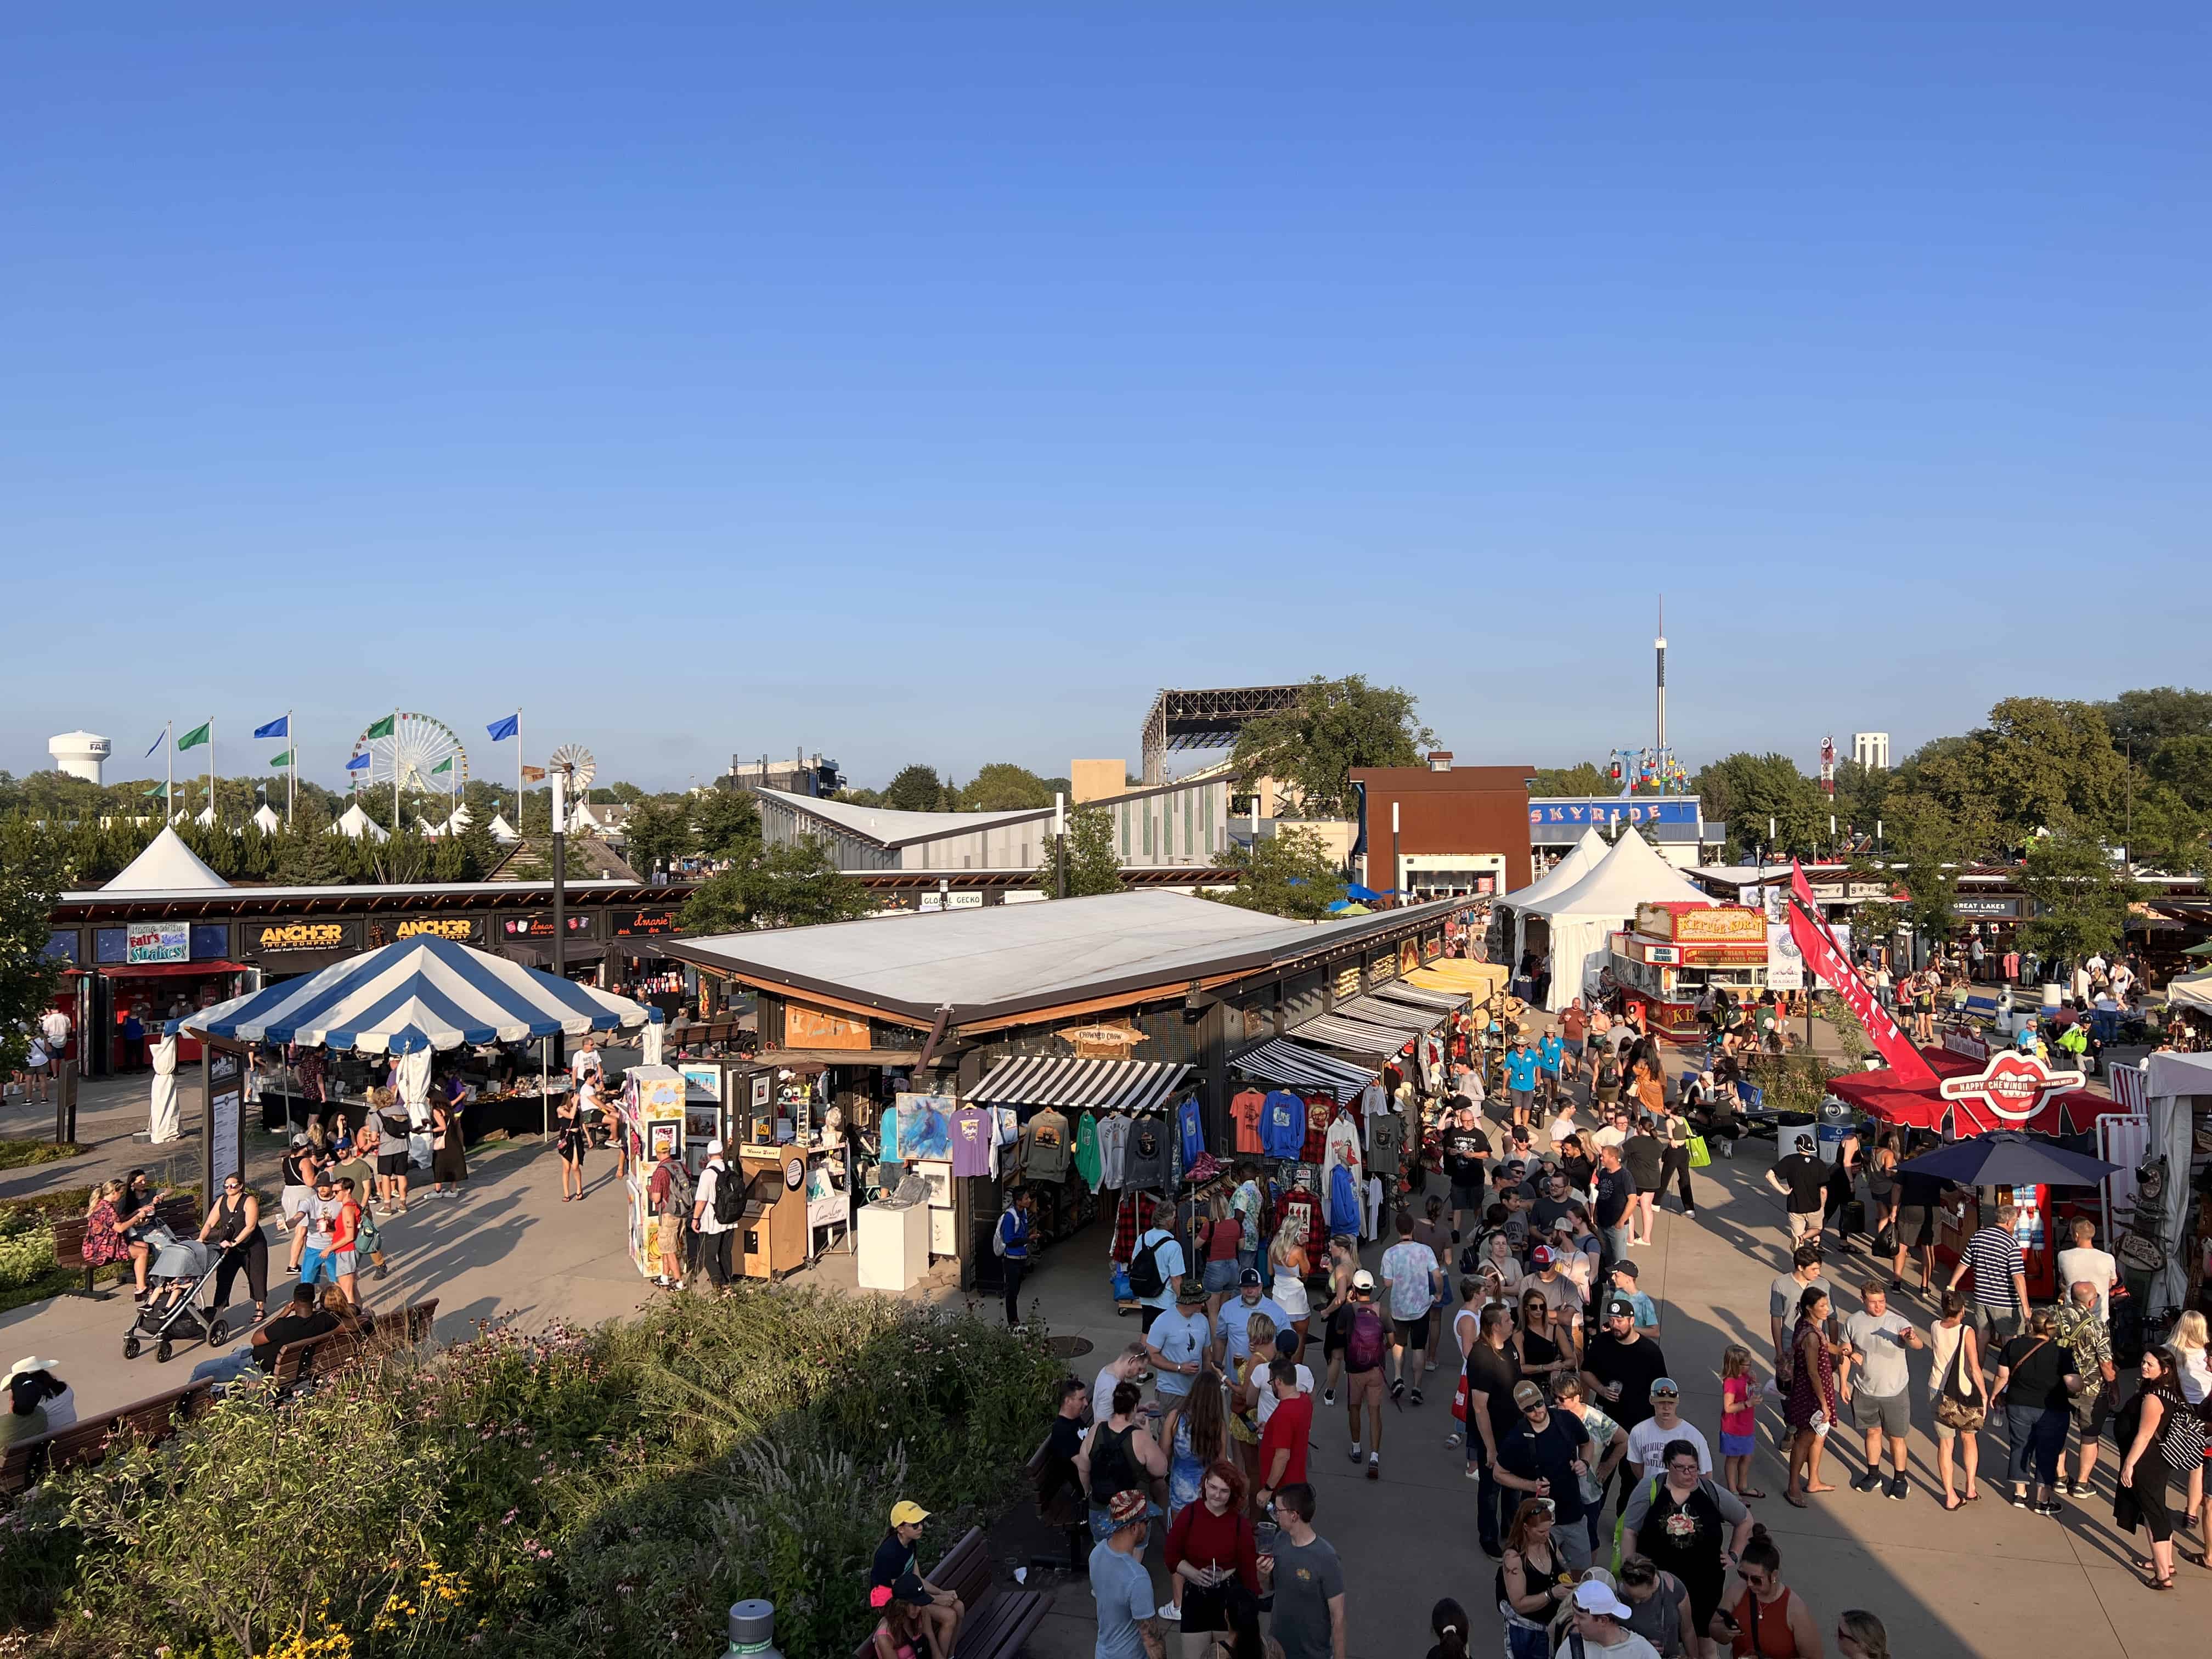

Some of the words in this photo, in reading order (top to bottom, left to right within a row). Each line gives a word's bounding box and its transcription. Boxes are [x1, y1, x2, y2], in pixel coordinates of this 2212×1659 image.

[1531, 805, 1661, 822] SKYRIDE
[259, 924, 342, 943] ANCHOR
[396, 919, 471, 936] ANCHOR
[1681, 919, 1726, 934] KETTLE
[1729, 918, 1760, 931] KORN
[129, 932, 160, 947] Fair's
[131, 945, 187, 962] Shakes!
[1079, 1031, 1105, 1040] CROWNED
[1107, 1032, 1122, 1041] CROW
[1959, 1081, 1984, 1091] HAPPY
[759, 1125, 768, 1133] EAT
